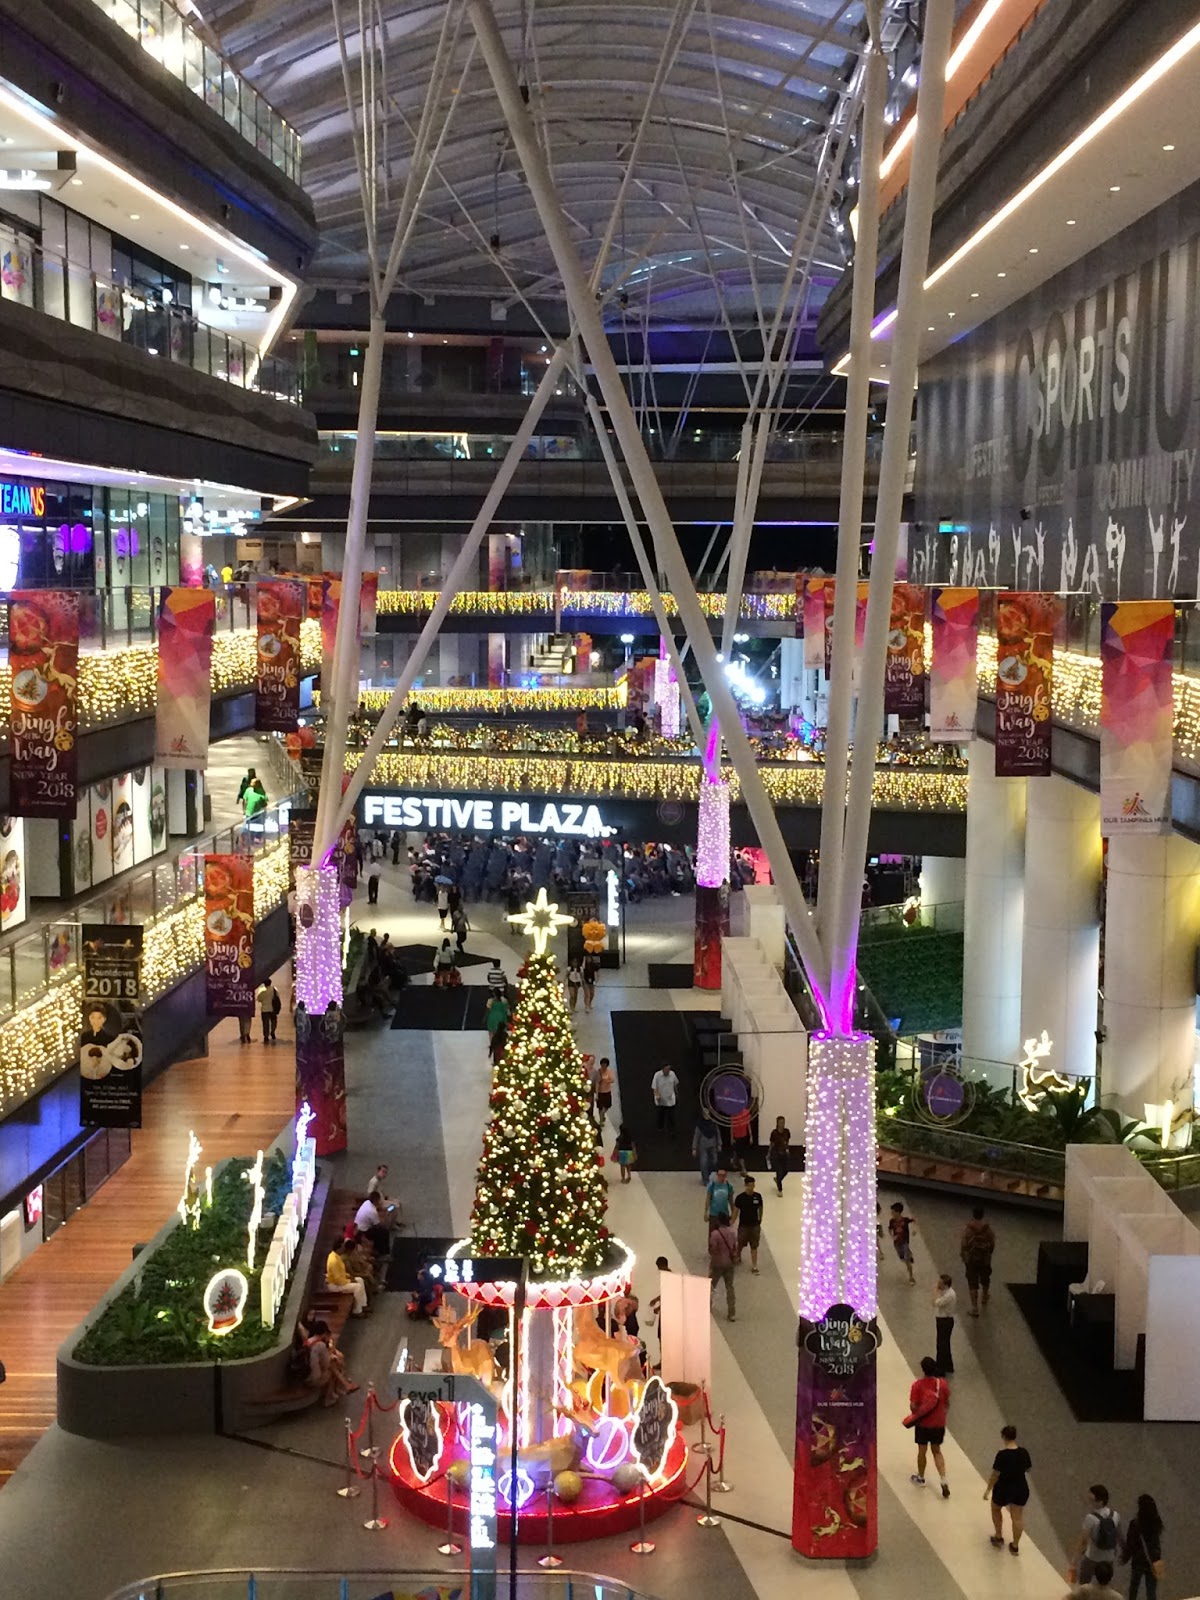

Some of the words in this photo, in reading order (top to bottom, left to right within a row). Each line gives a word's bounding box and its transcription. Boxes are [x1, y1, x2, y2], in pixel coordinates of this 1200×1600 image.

[1028, 316, 1132, 440] SPORTS
[997, 684, 1051, 715] Jingle
[11, 705, 77, 743] Jingle
[272, 706, 298, 719] 2018
[998, 711, 1036, 738] Way
[14, 737, 58, 772] Way
[1017, 746, 1049, 760] 2018
[13, 771, 36, 779] NEW
[40, 771, 68, 781] YEAR
[37, 780, 75, 798] 2018
[364, 795, 494, 830] FESTIVE
[501, 801, 606, 836] PLAZA
[207, 935, 253, 963] Jingle
[89, 968, 134, 978] Countdown
[208, 959, 241, 984] Way
[87, 978, 137, 996] 2018
[225, 989, 253, 1002] 2018
[818, 1311, 863, 1338] Jingle
[819, 1334, 851, 1357] Way
[827, 1362, 855, 1375] 2018
[397, 1387, 443, 1405] Level
[443, 1374, 456, 1401] 1
